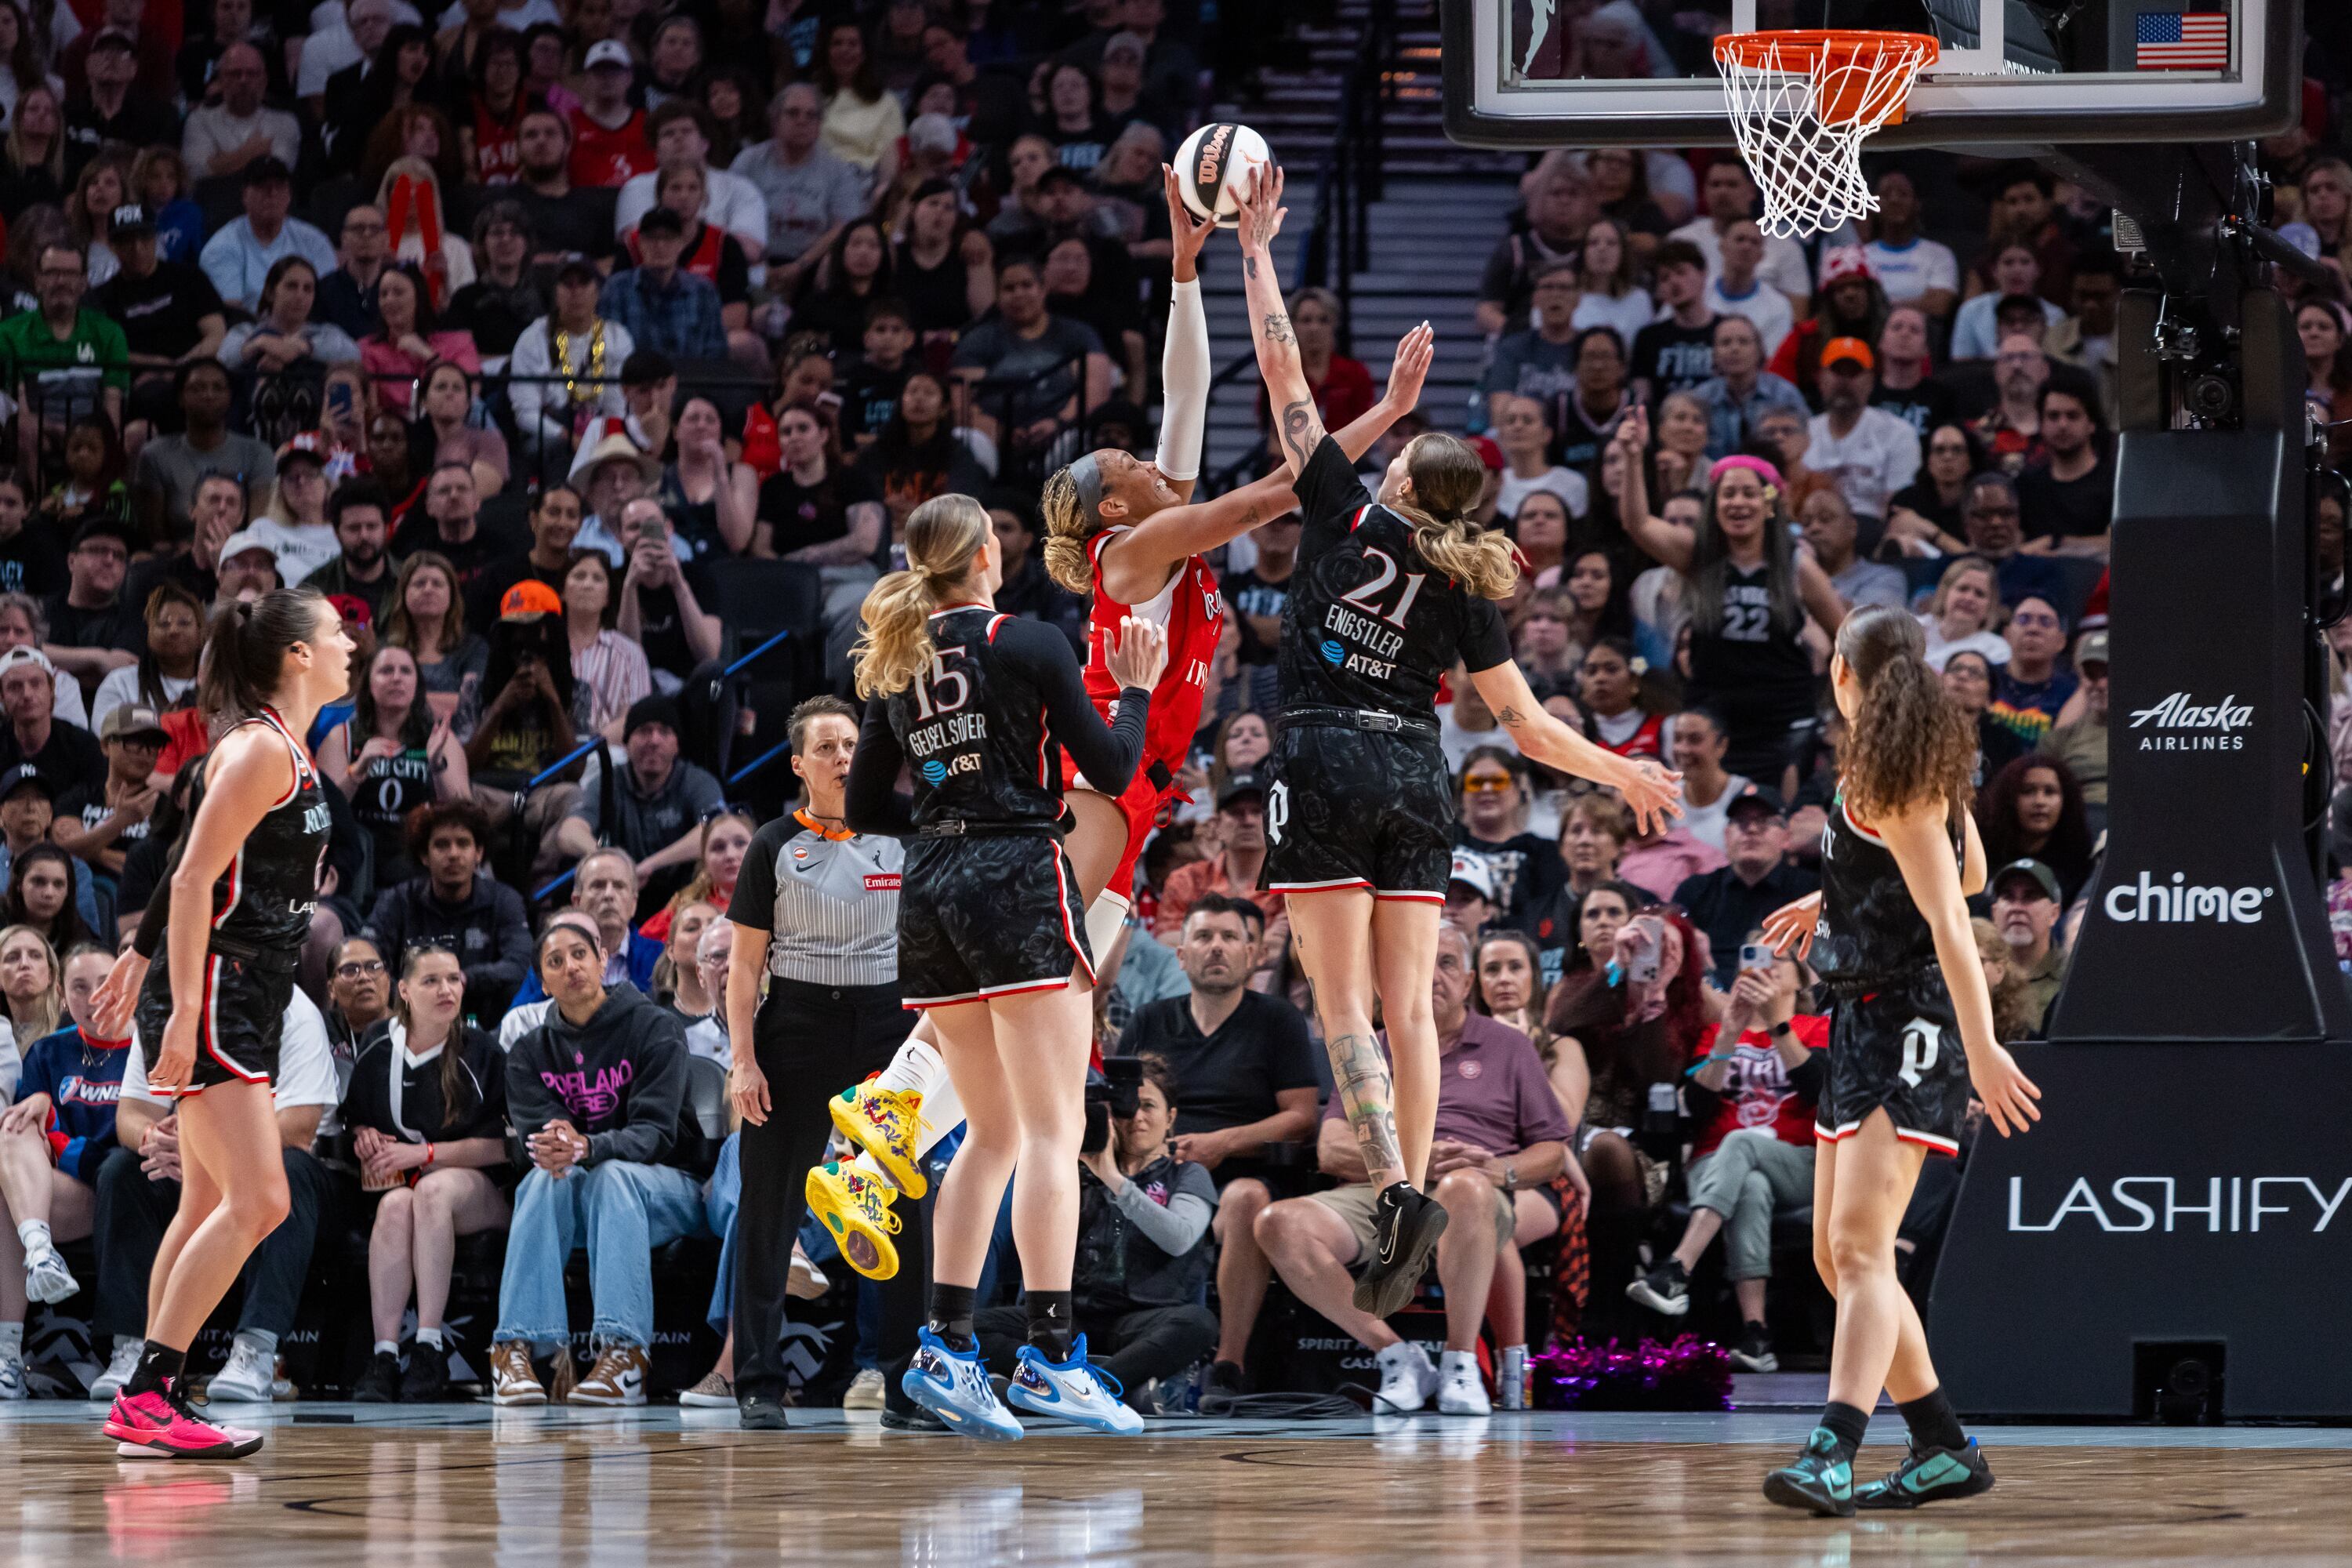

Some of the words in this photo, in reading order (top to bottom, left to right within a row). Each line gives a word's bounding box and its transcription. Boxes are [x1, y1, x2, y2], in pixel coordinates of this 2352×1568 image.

[1198, 125, 1233, 185] Wilson
[1340, 545, 1426, 630] 21
[1324, 604, 1404, 660] ENGSTLER
[1721, 605, 1770, 642] 22
[913, 646, 968, 722] 15
[1345, 653, 1397, 681] AT&T
[2129, 691, 2253, 732] Alaska
[2139, 736, 2244, 750] AIRLINES
[393, 757, 428, 783] CITY
[379, 777, 403, 812] 0
[864, 877, 902, 888] Emirates
[2104, 871, 2263, 924] chime
[80, 1084, 123, 1102] WNB
[2008, 1176, 2352, 1232] LASHIFY
[1298, 1337, 1353, 1351] SPIRIT
